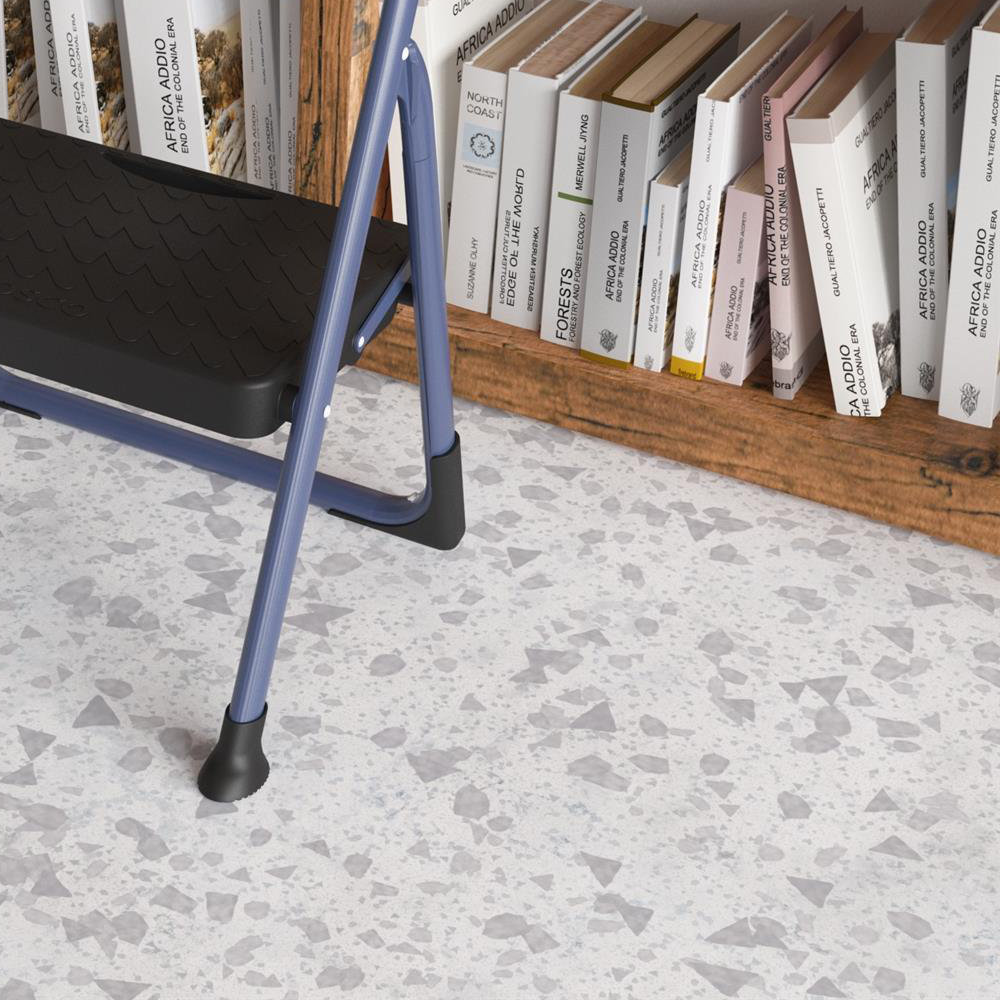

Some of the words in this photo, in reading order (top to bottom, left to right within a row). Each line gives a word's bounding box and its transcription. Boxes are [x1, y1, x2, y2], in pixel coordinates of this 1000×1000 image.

[166, 17, 175, 38] ERA
[456, 22, 493, 65] AFRICA
[47, 38, 58, 96] AFRICA
[66, 32, 78, 77] ADDIO
[154, 38, 170, 89] ADDIO
[169, 41, 181, 91] COLONIAL
[72, 81, 85, 133] AFRICA
[174, 94, 184, 113] THE
[466, 103, 502, 119] COAST
[467, 91, 503, 107] NORTH
[161, 93, 178, 152] AFRICA
[177, 116, 186, 130] OF
[179, 132, 189, 153] END
[579, 114, 589, 142] JIYNG
[985, 128, 996, 181] GUALTIERO
[991, 74, 1000, 126] JACOPETTI
[575, 145, 586, 190] MERWELL
[576, 211, 587, 250] ECOLOGY
[696, 199, 706, 239] ADDIO
[816, 187, 831, 239] JACOPETTI
[989, 209, 998, 229] ERA
[608, 230, 619, 262] ADDIO
[917, 220, 927, 265] ADDIO
[973, 228, 986, 277] ADDIO
[985, 232, 996, 279] COLONIAL
[574, 251, 583, 282] FOREST
[605, 264, 616, 300] AFRICA
[691, 242, 702, 287] AFRICA
[825, 242, 840, 296] GUALTIERO
[555, 268, 573, 340] FORESTS
[572, 281, 580, 302] AND
[918, 268, 931, 319] AFRICA
[929, 287, 935, 300] OF
[968, 281, 982, 336] AFRICA
[981, 302, 989, 316] OF
[983, 281, 991, 299] THE
[569, 302, 578, 343] FORESTRY
[849, 323, 859, 343] ERA
[979, 318, 987, 338] END
[839, 344, 857, 394] ADDIO
[853, 346, 867, 395] COLONIAL
